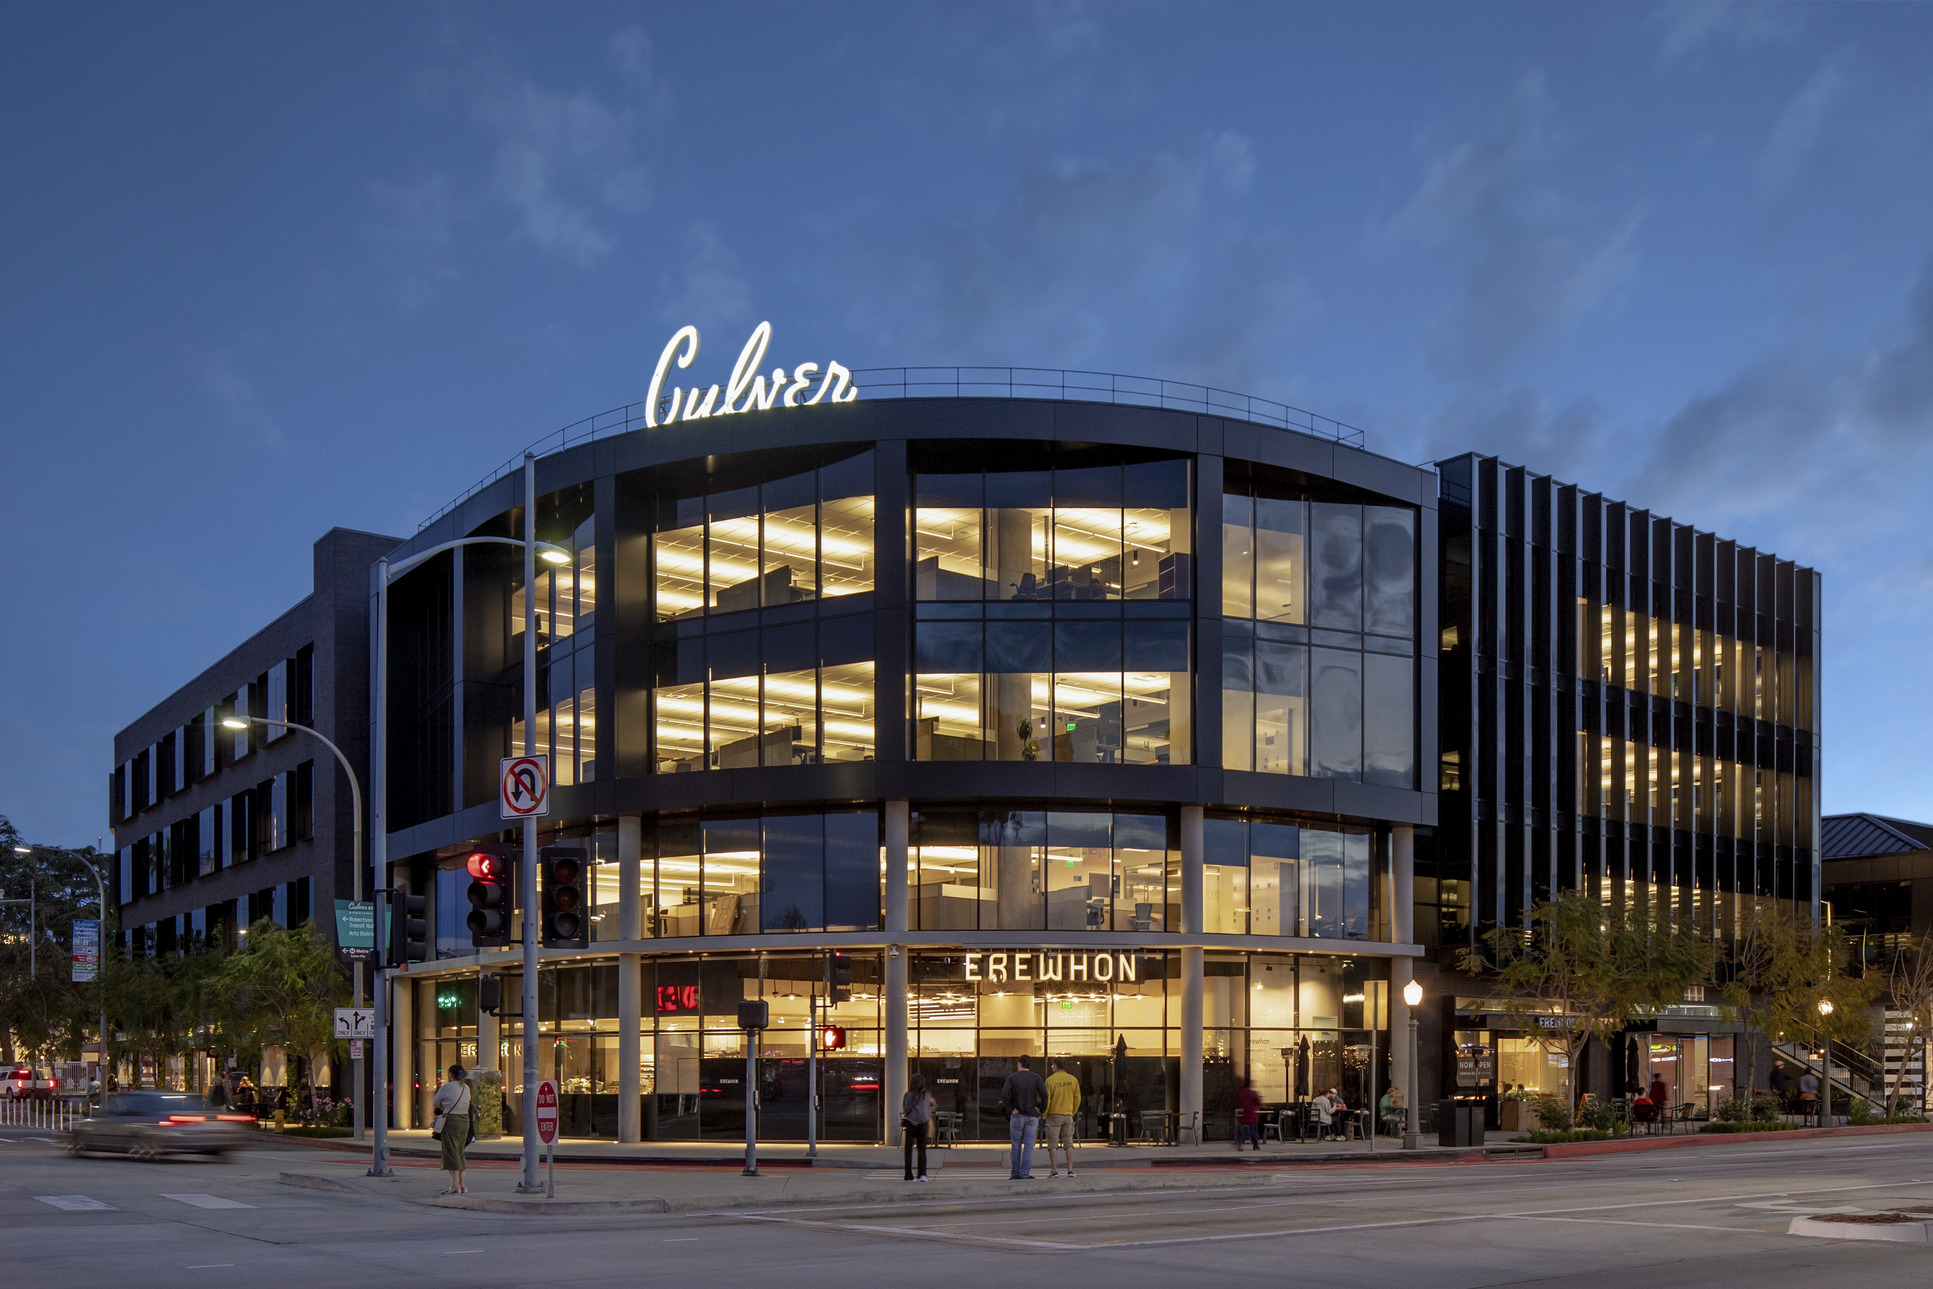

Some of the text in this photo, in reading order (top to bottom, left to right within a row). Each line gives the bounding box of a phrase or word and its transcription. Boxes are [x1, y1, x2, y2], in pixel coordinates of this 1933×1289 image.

[645, 320, 858, 428] Culver
[348, 902, 367, 910] Culver
[965, 953, 1136, 982] EREWHON
[1459, 1061, 1474, 1069] NOW
[1055, 1080, 1073, 1088] TEAM
[539, 1094, 554, 1104] DO NOT
[541, 1121, 553, 1132] ENTER
